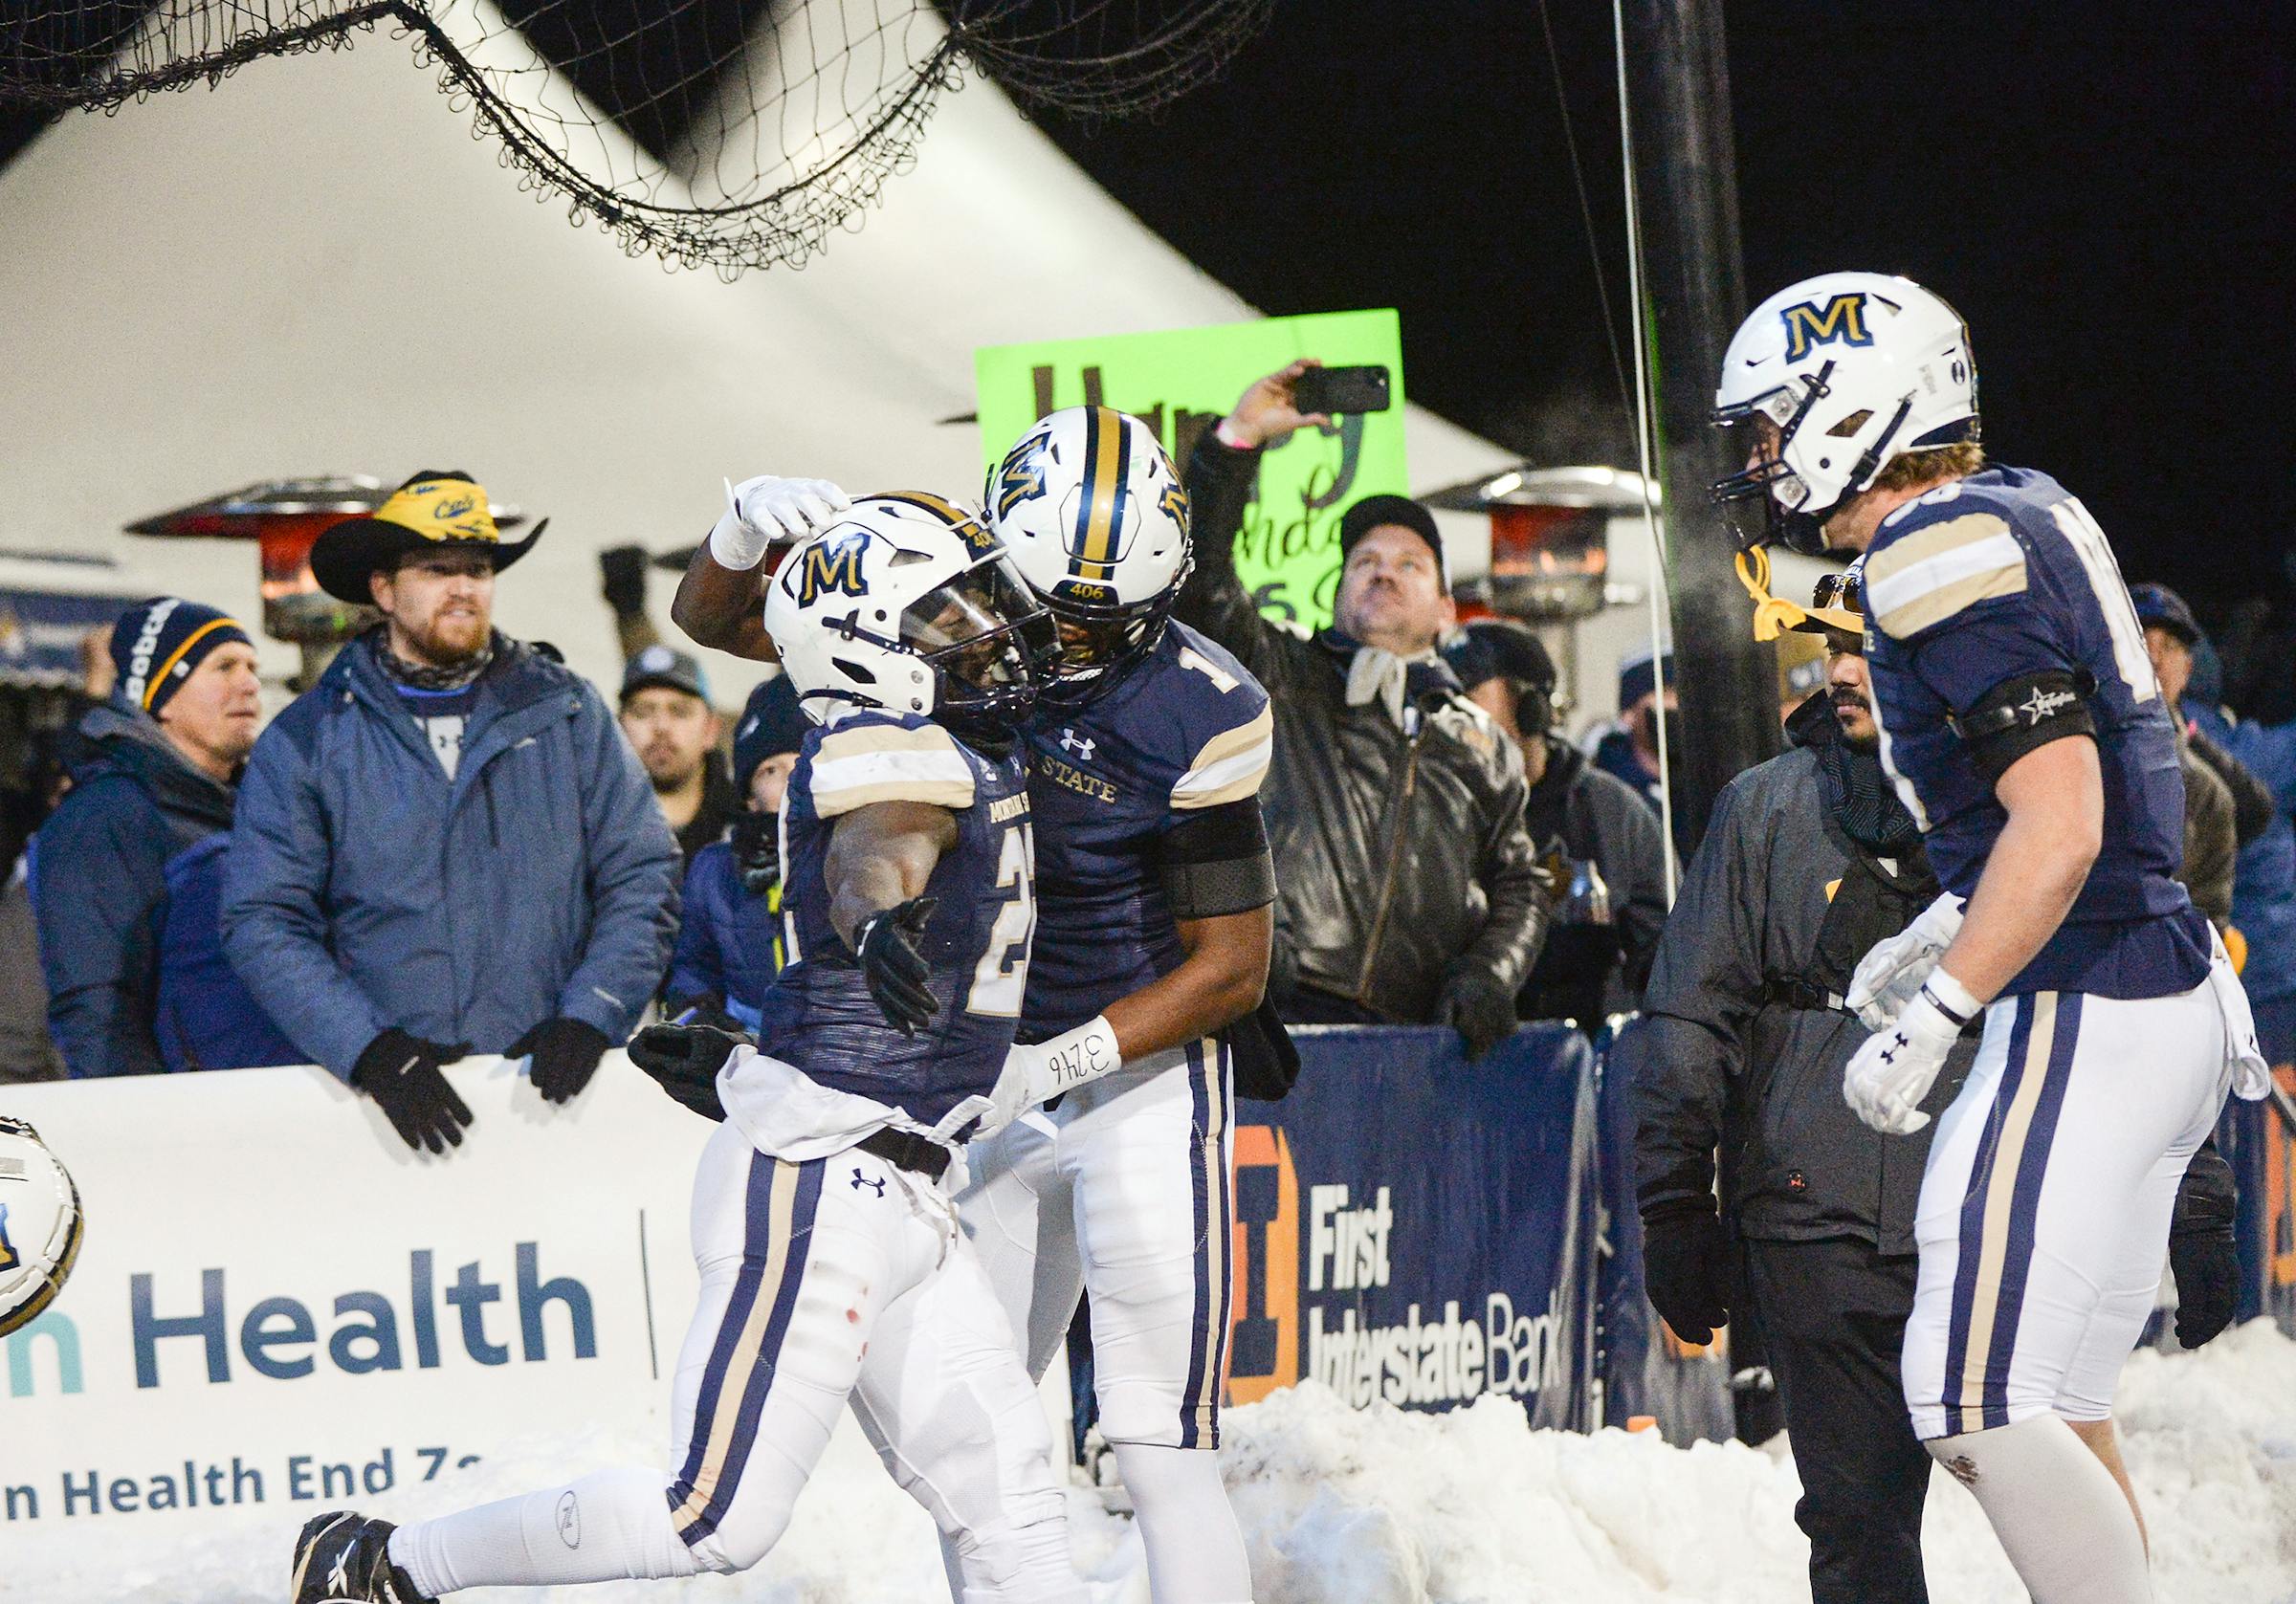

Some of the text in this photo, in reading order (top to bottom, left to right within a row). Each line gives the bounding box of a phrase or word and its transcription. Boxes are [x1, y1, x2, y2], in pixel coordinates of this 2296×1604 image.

[1780, 293, 1874, 364] M
[799, 532, 872, 609] M
[1070, 582, 1104, 600] 406
[1179, 647, 1241, 694] 1
[1041, 755, 1118, 805] STATE
[1308, 1183, 1394, 1292] First
[128, 1241, 598, 1390] Health
[1308, 1300, 1485, 1412] Interstate
[61, 1456, 266, 1517] Health
[288, 1447, 395, 1501] End
